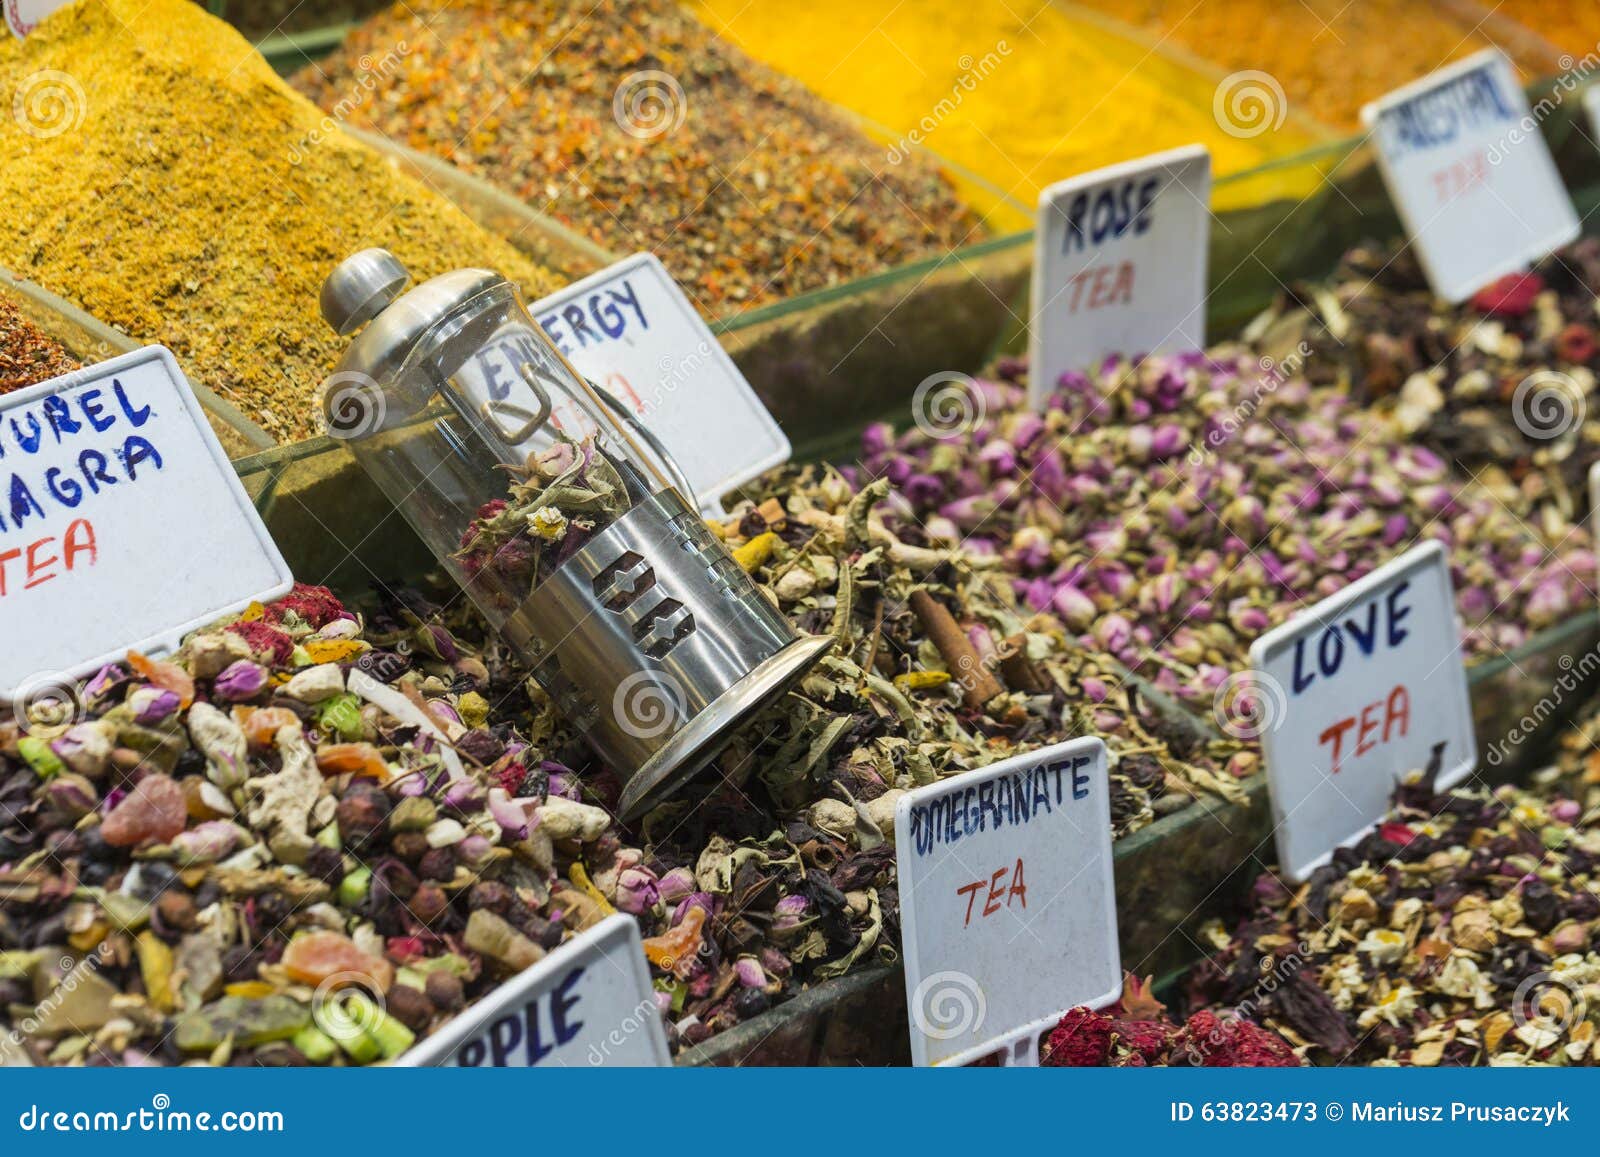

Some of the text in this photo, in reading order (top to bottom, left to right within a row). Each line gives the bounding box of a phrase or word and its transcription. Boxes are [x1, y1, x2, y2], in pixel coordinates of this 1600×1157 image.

[1062, 175, 1159, 257] ROSE
[1067, 259, 1136, 316] TEA
[0, 378, 151, 458] UREL
[0, 518, 97, 596] TEA
[1293, 580, 1411, 695] LOVE
[1319, 683, 1410, 774] TEA
[956, 857, 1027, 929] TEA
